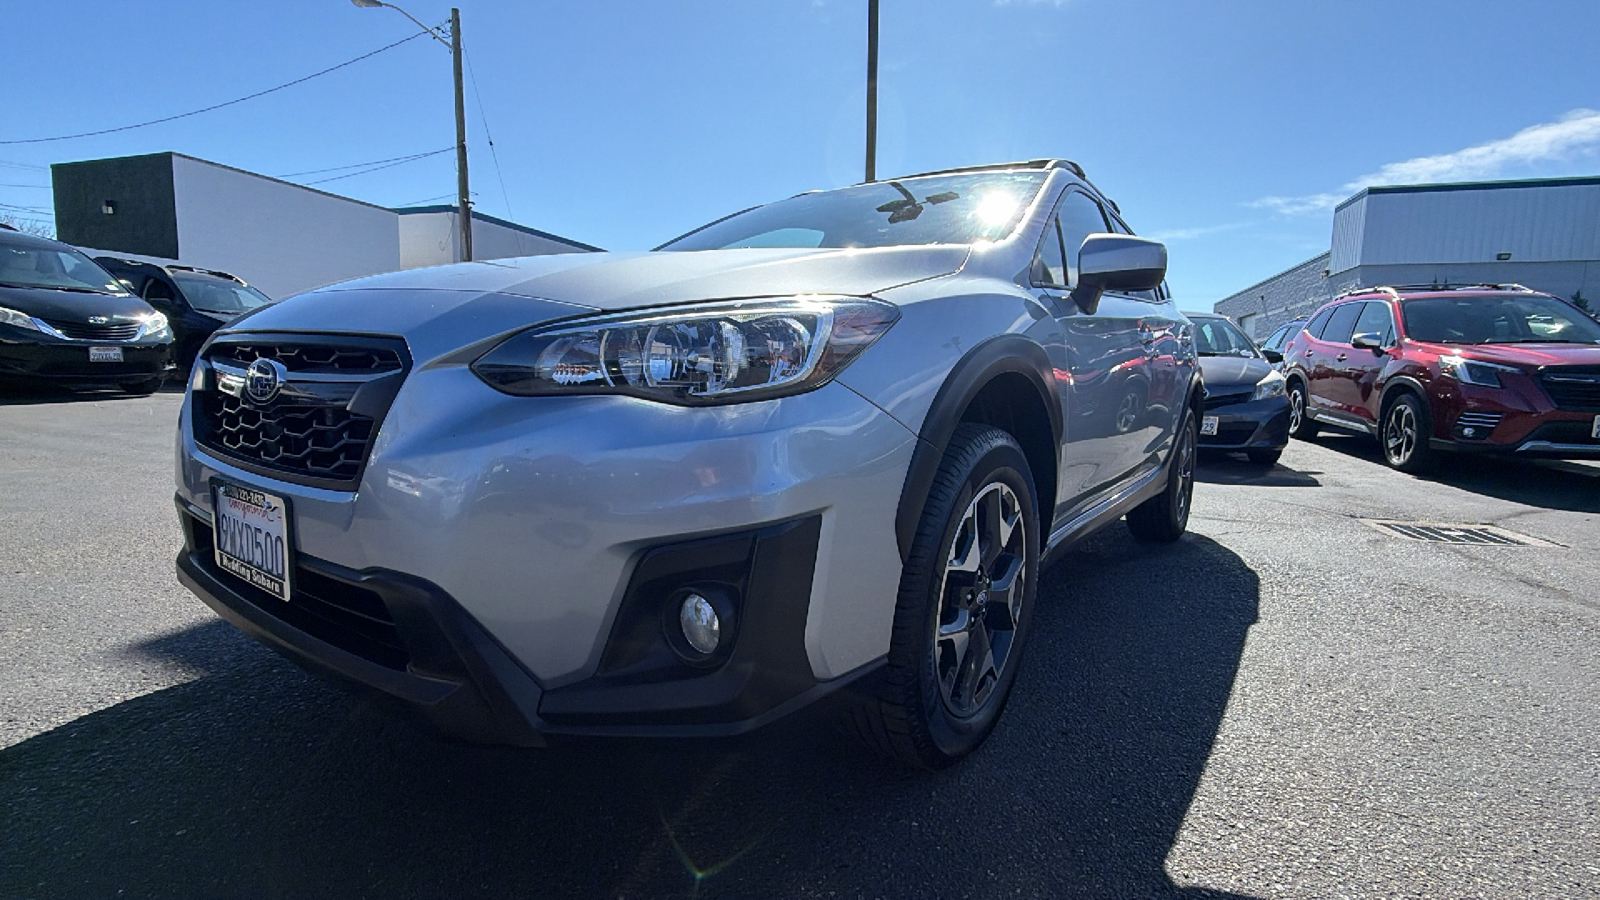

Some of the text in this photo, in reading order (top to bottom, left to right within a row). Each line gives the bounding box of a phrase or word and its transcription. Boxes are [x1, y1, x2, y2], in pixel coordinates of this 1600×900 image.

[221, 513, 284, 579] 9WXD500
[222, 554, 280, 593] Redding Subaru
